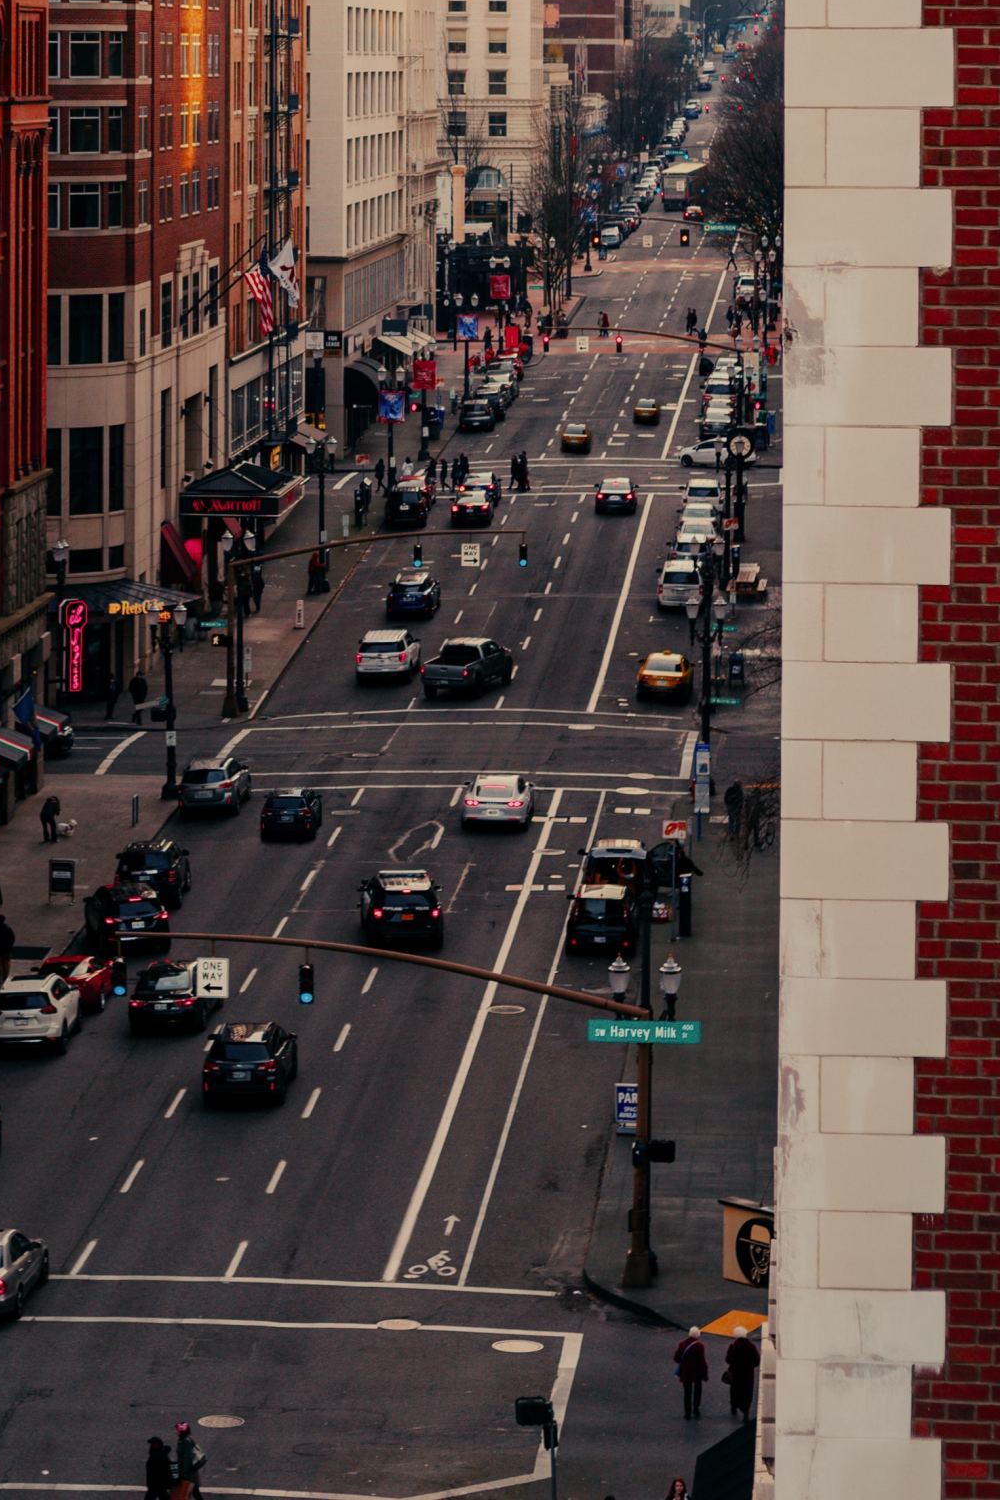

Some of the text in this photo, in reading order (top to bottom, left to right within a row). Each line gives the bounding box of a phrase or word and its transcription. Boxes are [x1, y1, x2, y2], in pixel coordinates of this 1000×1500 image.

[207, 499, 263, 513] Marriott
[202, 961, 223, 971] ONE
[202, 972, 223, 980] WAY
[594, 1025, 677, 1041] SW Harvey Milk
[618, 1092, 638, 1104] PAR
